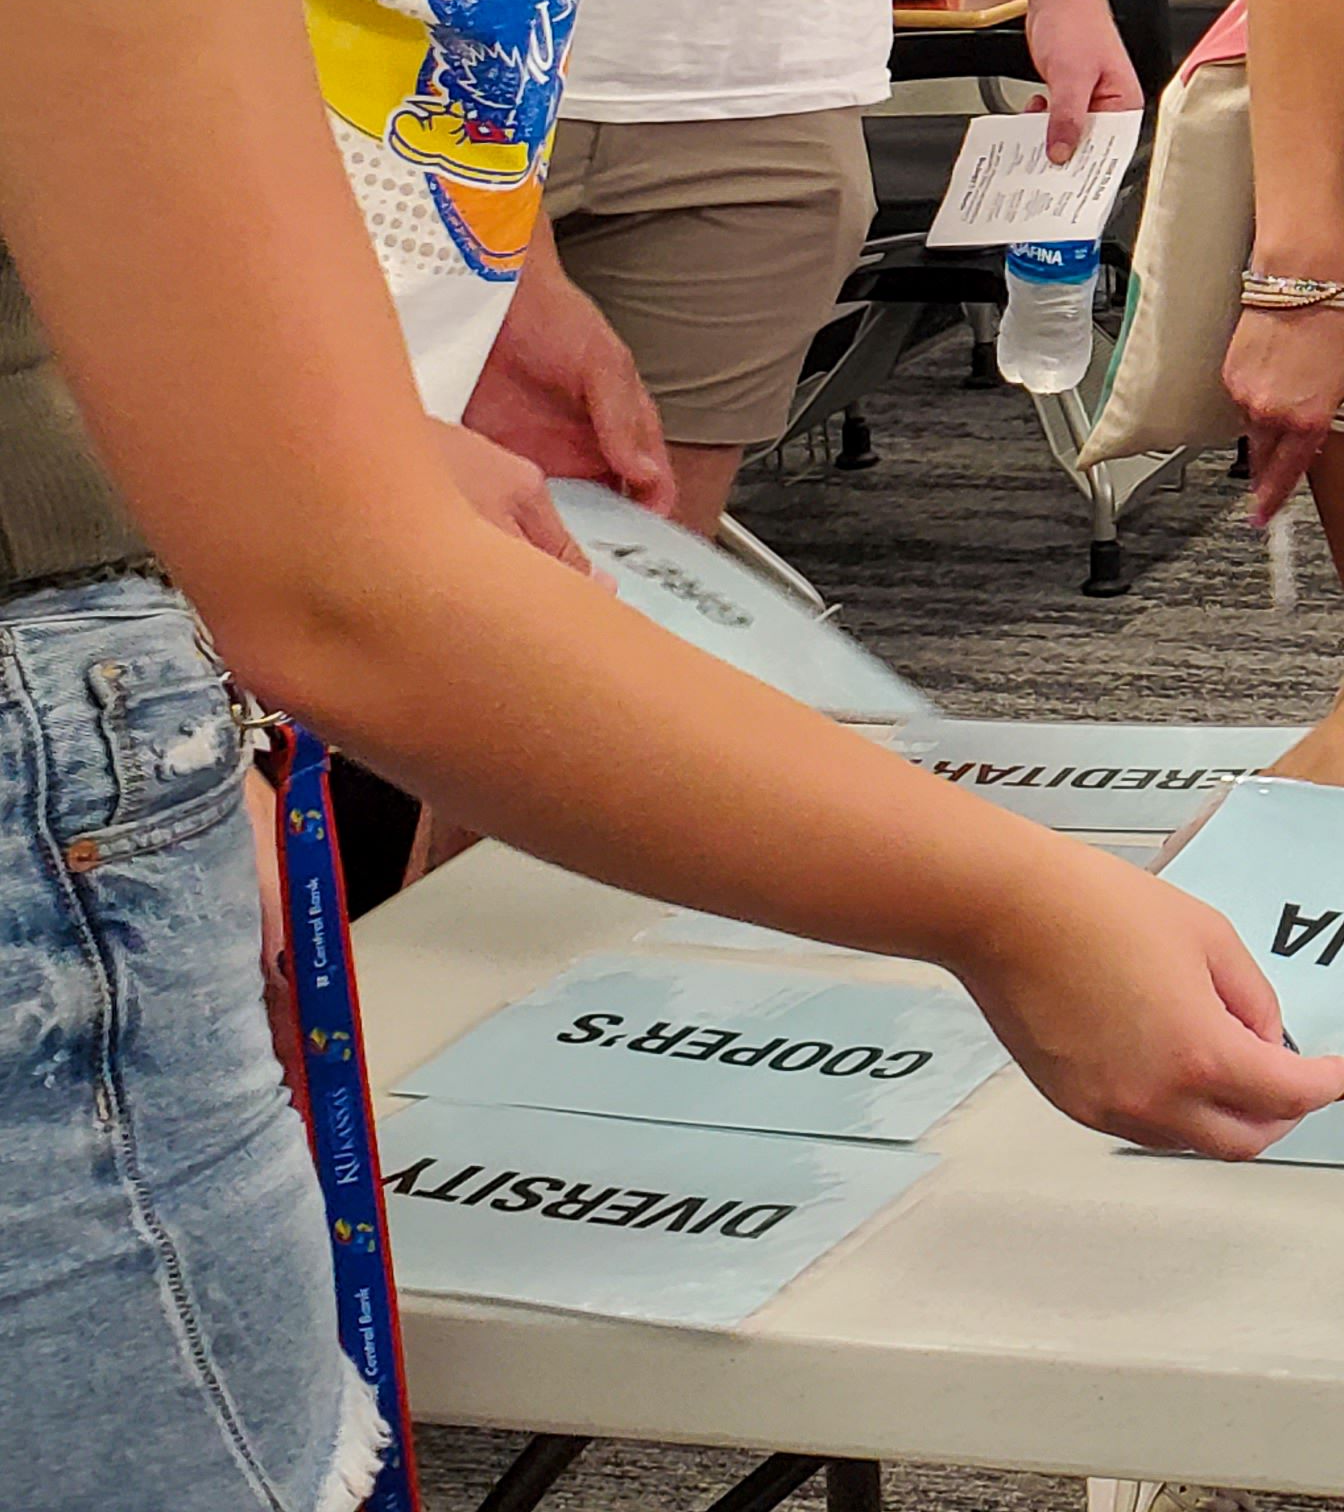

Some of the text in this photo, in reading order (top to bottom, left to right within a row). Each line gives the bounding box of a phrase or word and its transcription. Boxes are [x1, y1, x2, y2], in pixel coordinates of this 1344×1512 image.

[906, 759, 1262, 790] EREDITAR
[556, 1012, 934, 1081] COOPER'S
[380, 1157, 797, 1240] DIVERSITY
